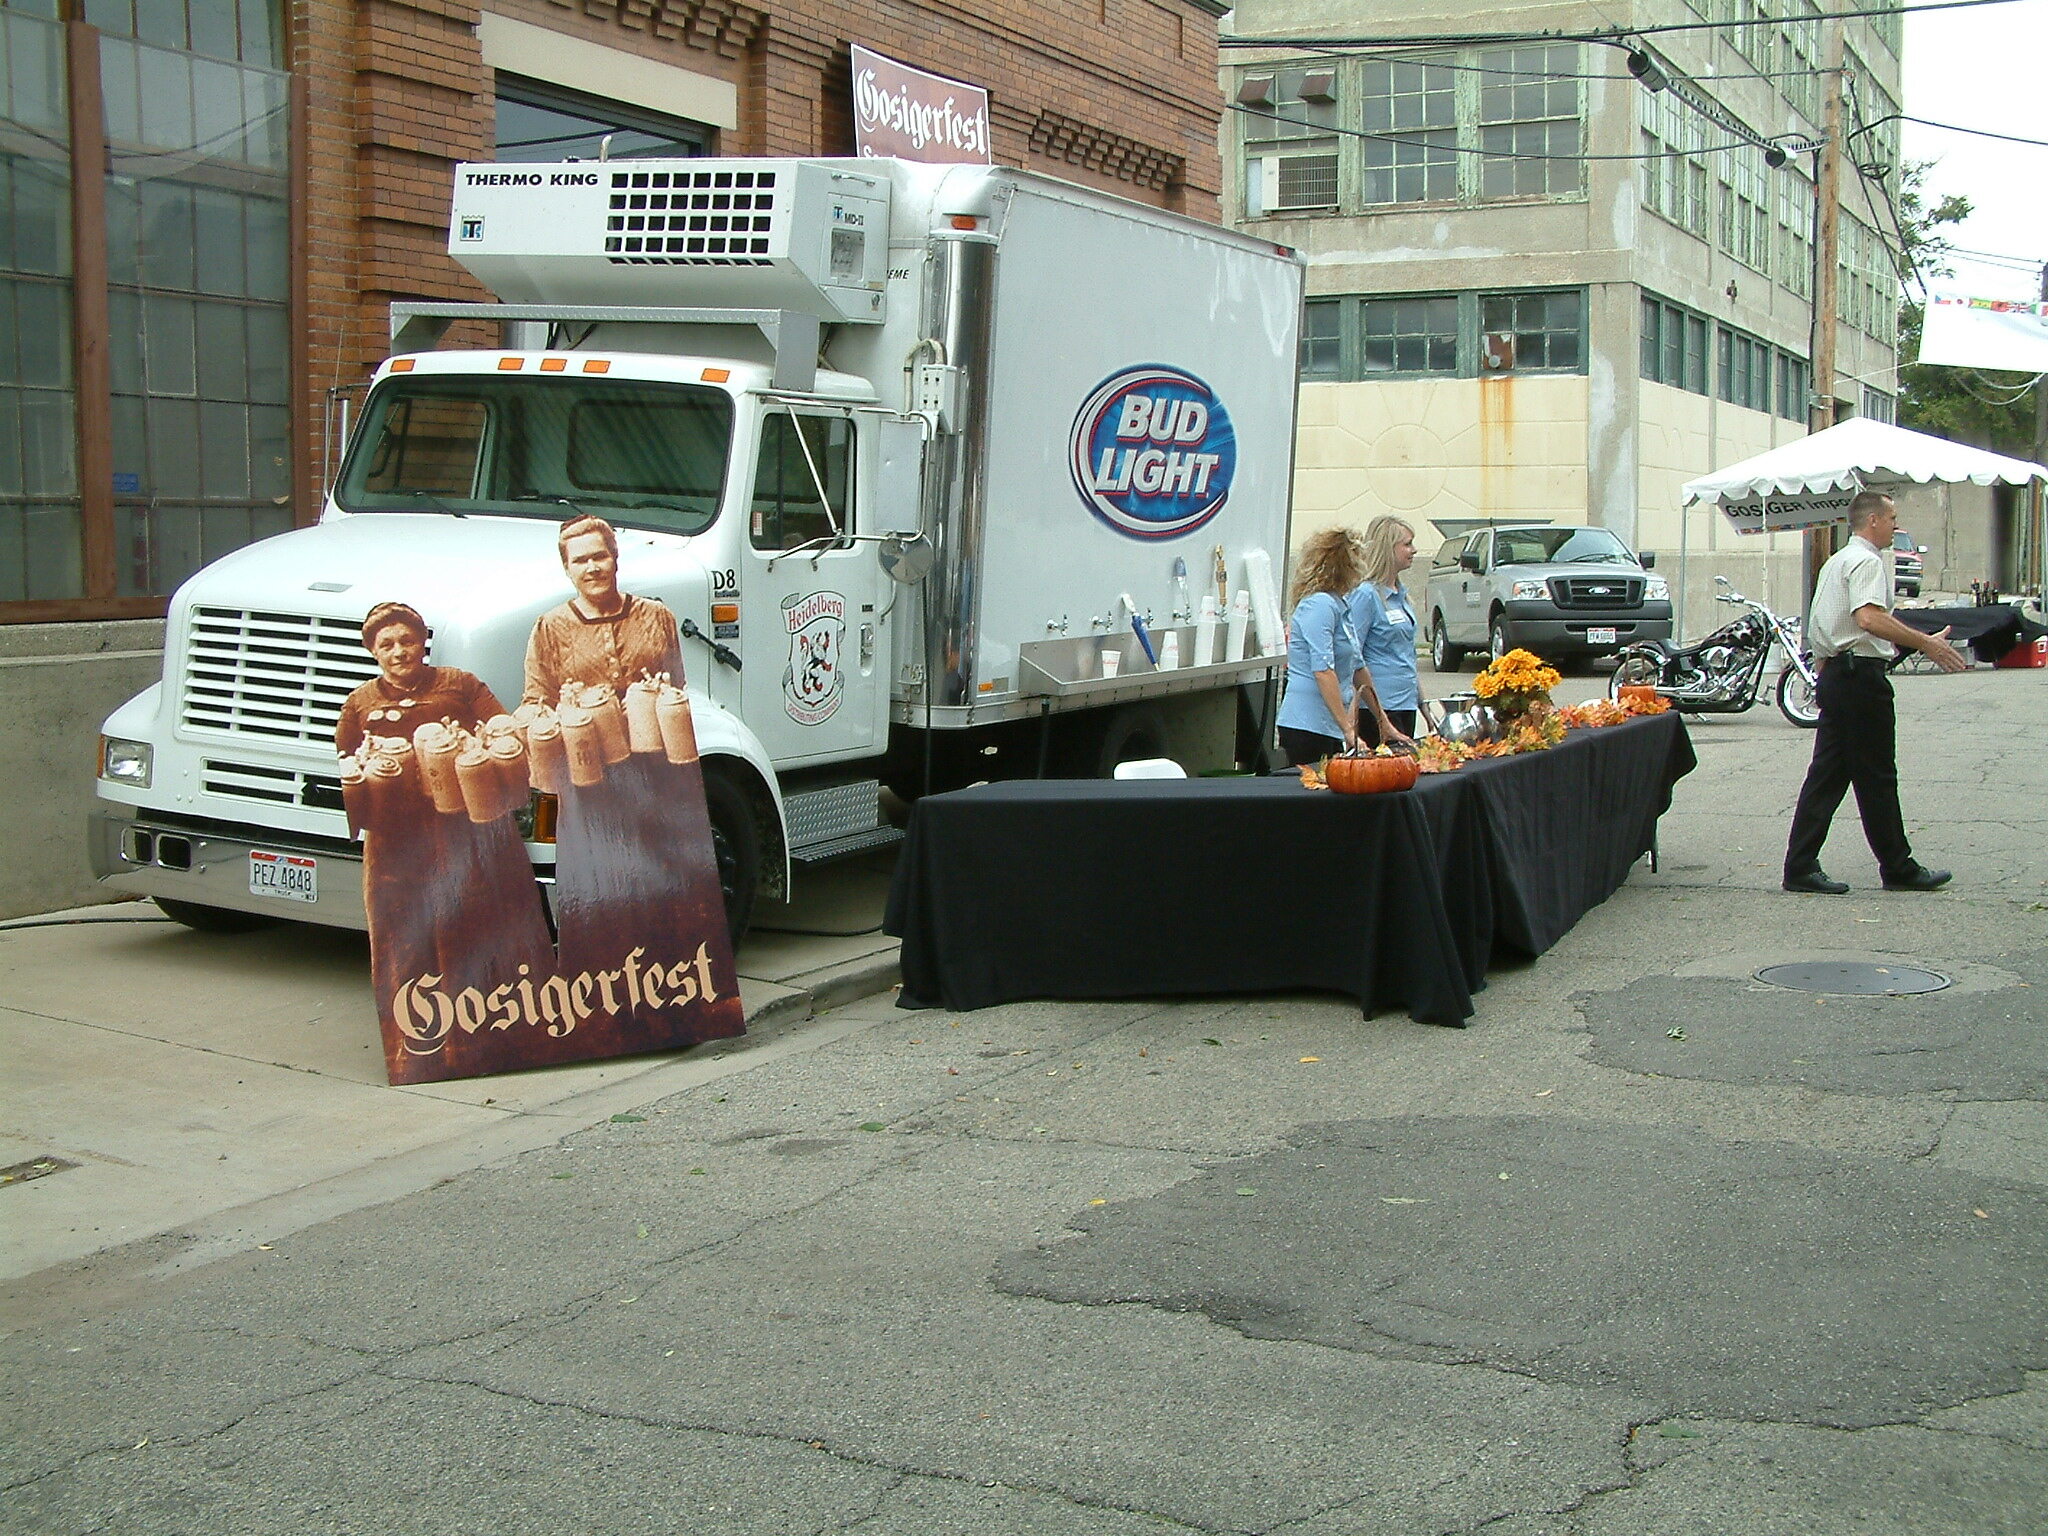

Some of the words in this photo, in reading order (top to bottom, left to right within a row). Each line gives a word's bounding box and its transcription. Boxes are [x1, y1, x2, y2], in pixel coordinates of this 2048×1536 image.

[856, 68, 987, 156] Gosigerfest
[465, 174, 543, 187] THERMO
[550, 173, 599, 187] KING
[1116, 394, 1209, 446] BUD
[1094, 447, 1220, 498] LIGHT
[1806, 498, 1851, 511] Impo
[711, 568, 735, 590] D8
[788, 595, 843, 631] Heidelberg
[254, 862, 276, 887] PEZ
[281, 866, 312, 892] 4848
[393, 941, 719, 1057] Gosigerfest
